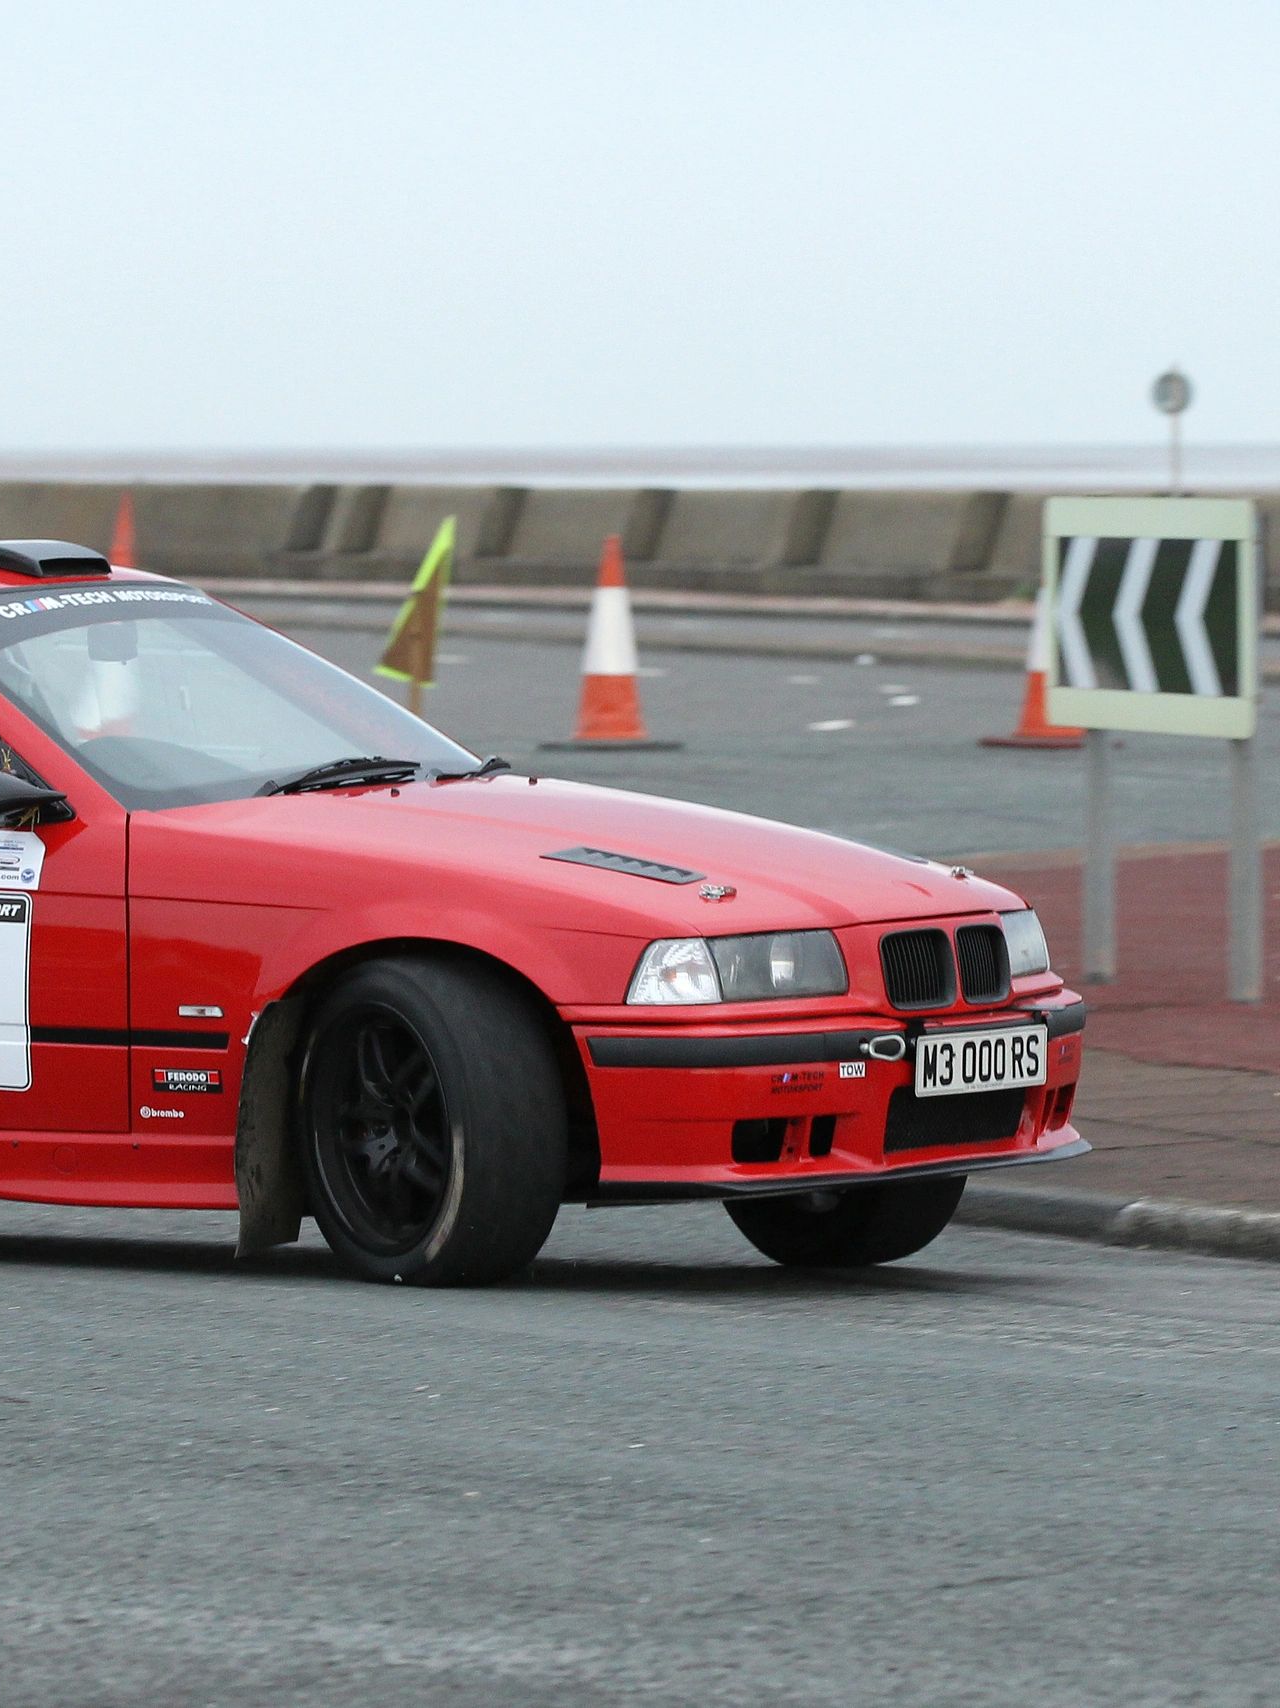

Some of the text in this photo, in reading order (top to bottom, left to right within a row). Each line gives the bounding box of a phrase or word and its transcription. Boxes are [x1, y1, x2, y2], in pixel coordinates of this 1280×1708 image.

[923, 1043, 954, 1088] M3
[1012, 1034, 1039, 1079] RS
[841, 1063, 864, 1076] TOW
[167, 1071, 207, 1082] FERODO
[168, 1083, 207, 1092] RACING
[151, 1107, 185, 1118] brembo
